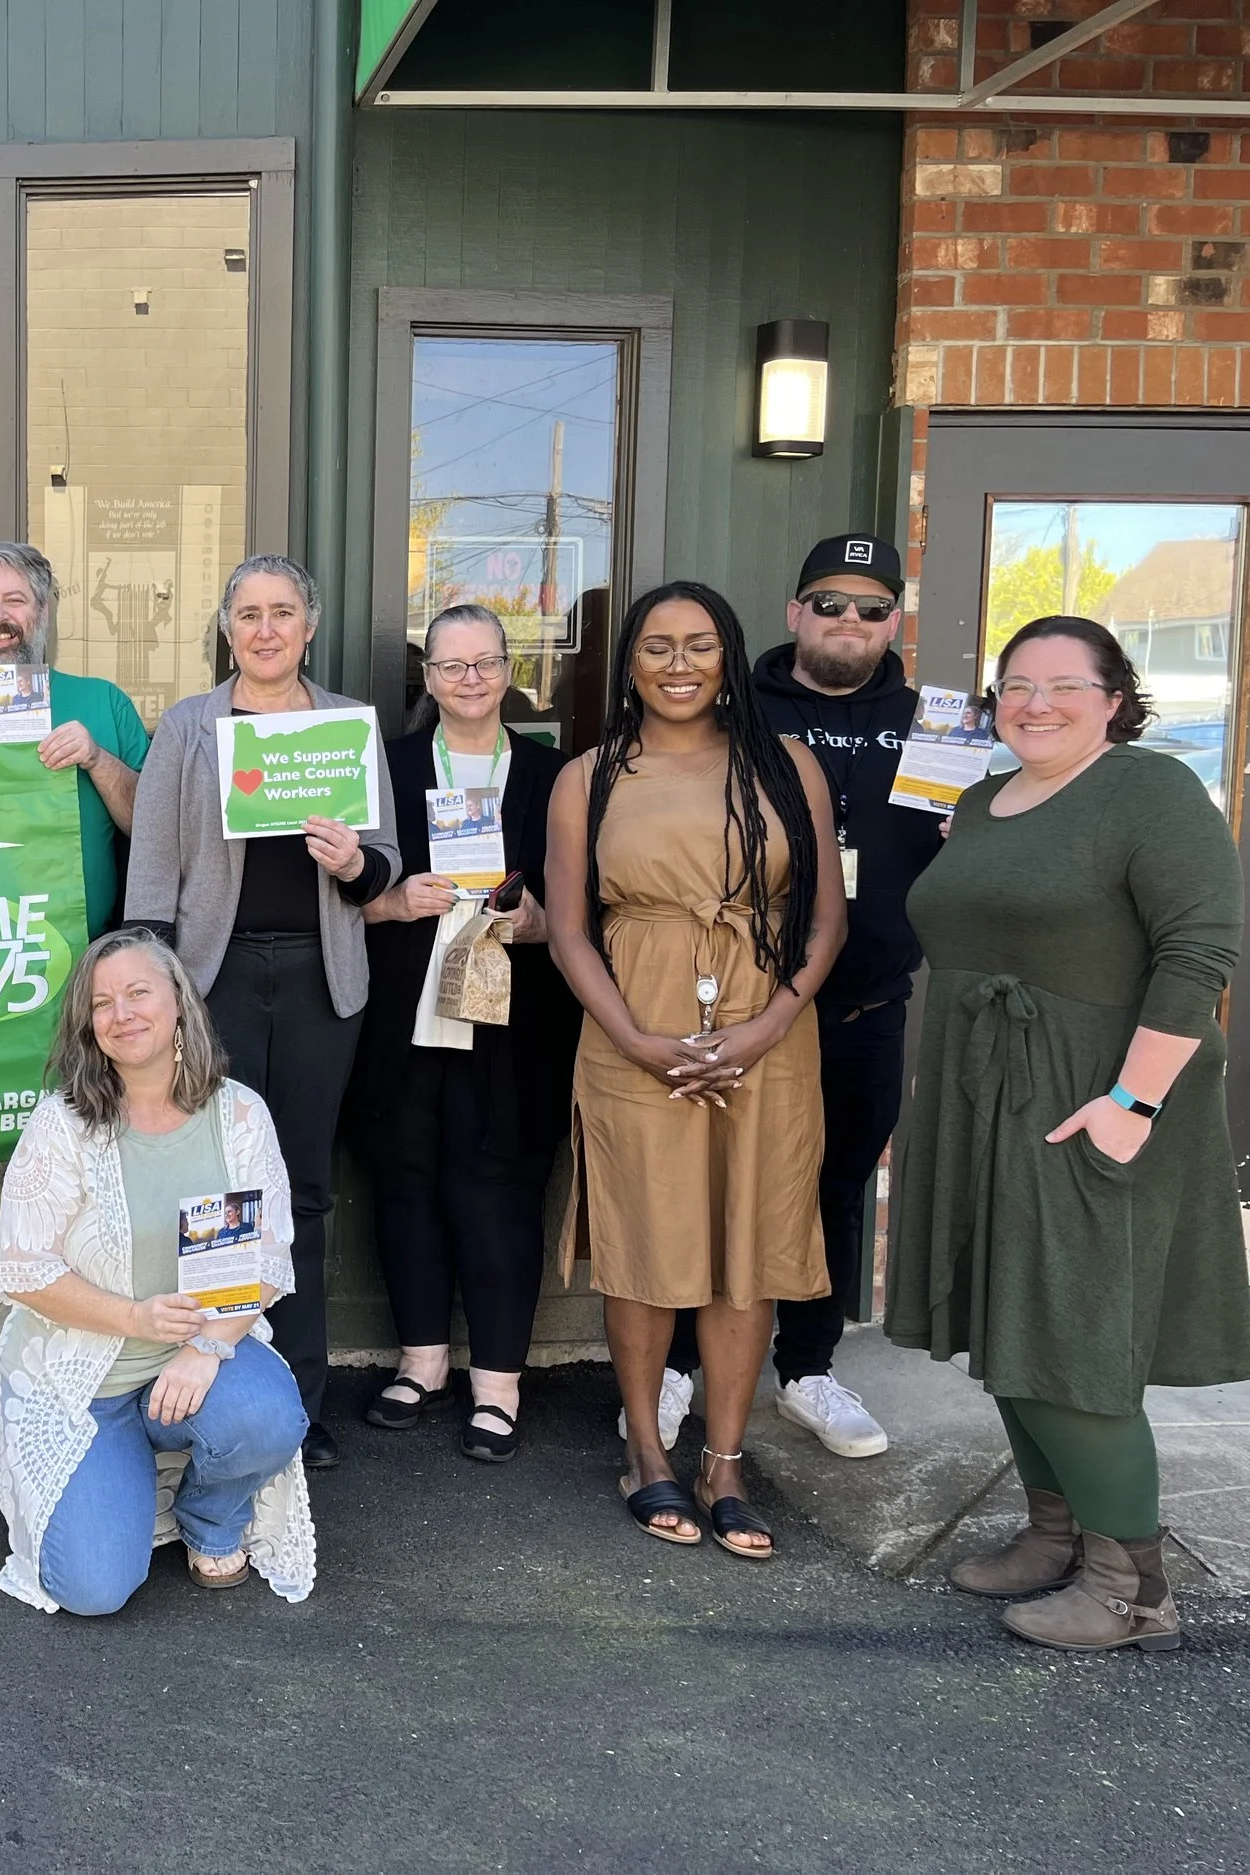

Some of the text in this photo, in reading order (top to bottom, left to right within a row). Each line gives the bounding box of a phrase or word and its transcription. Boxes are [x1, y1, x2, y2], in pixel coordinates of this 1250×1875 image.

[114, 498, 135, 509] Build
[109, 510, 122, 519] But
[120, 520, 134, 529] part
[487, 552, 522, 580] NO
[930, 697, 962, 709] LISA
[262, 748, 357, 766] We Support
[264, 766, 361, 783] Lane County
[264, 786, 332, 801] Workers
[437, 795, 463, 807] LISA
[0, 1111, 31, 1132] BE
[191, 1201, 222, 1217] LISA
